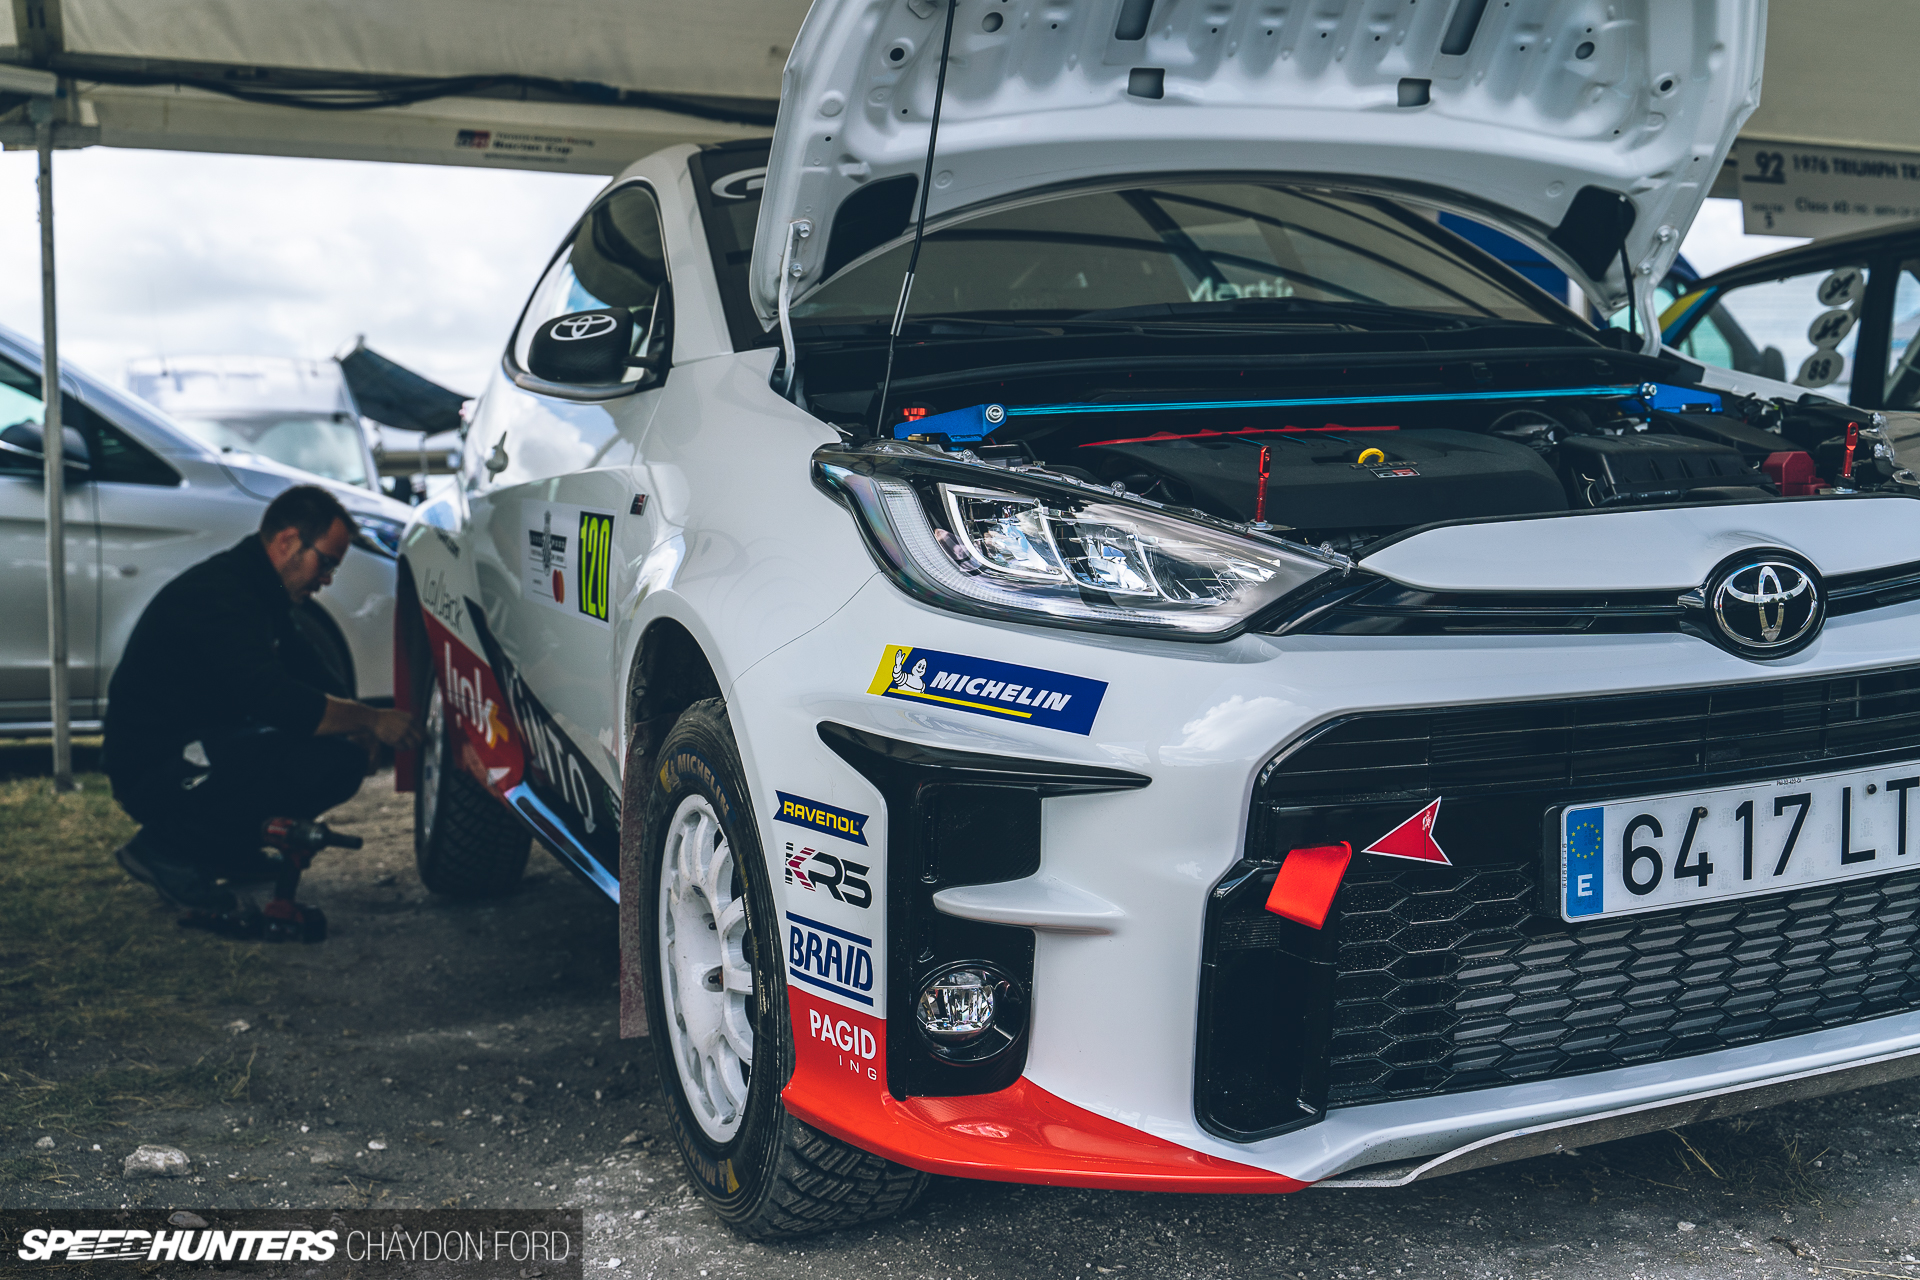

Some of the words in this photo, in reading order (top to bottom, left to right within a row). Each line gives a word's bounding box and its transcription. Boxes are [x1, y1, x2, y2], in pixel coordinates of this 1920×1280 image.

[1755, 151, 1785, 177] 92
[581, 516, 610, 619] 120
[930, 671, 1072, 712] MICHELIN
[677, 753, 730, 817] MICHELIN
[783, 801, 859, 836] RAVENOL
[1622, 792, 1812, 896] 6417
[1841, 776, 1920, 865] LT
[1577, 873, 1593, 898] E
[789, 924, 874, 992] BRAID
[809, 1008, 877, 1060] PAGID
